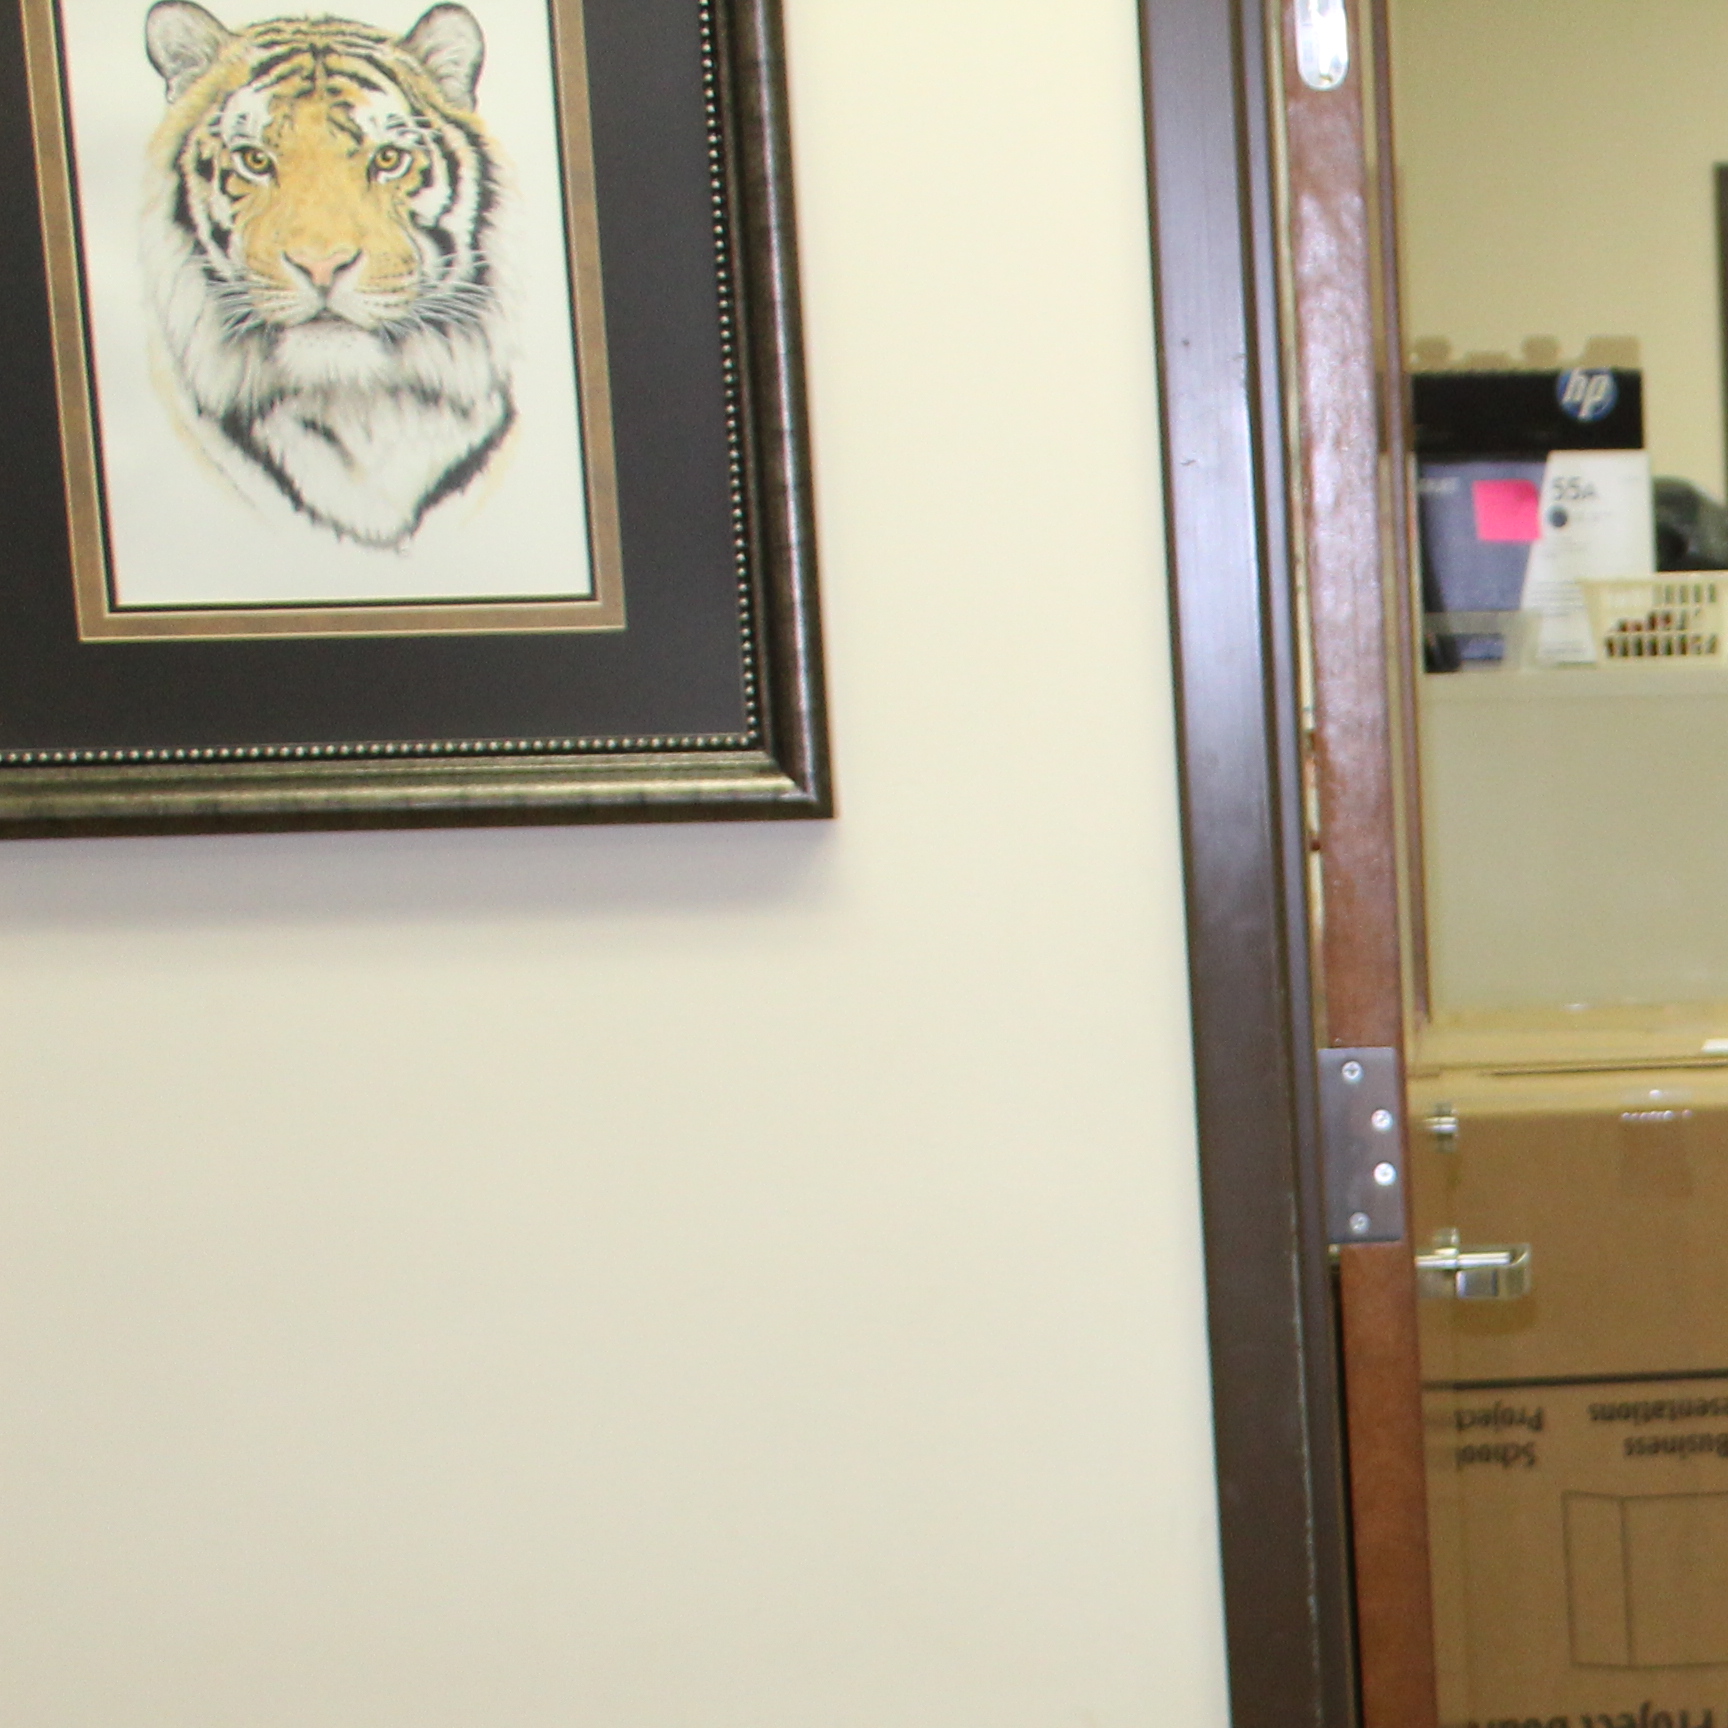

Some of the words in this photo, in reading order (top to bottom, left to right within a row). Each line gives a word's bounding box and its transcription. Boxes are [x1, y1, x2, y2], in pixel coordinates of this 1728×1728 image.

[1561, 369, 1613, 420] hp
[1454, 1403, 1545, 1434] Project
[1456, 1441, 1537, 1471] School
